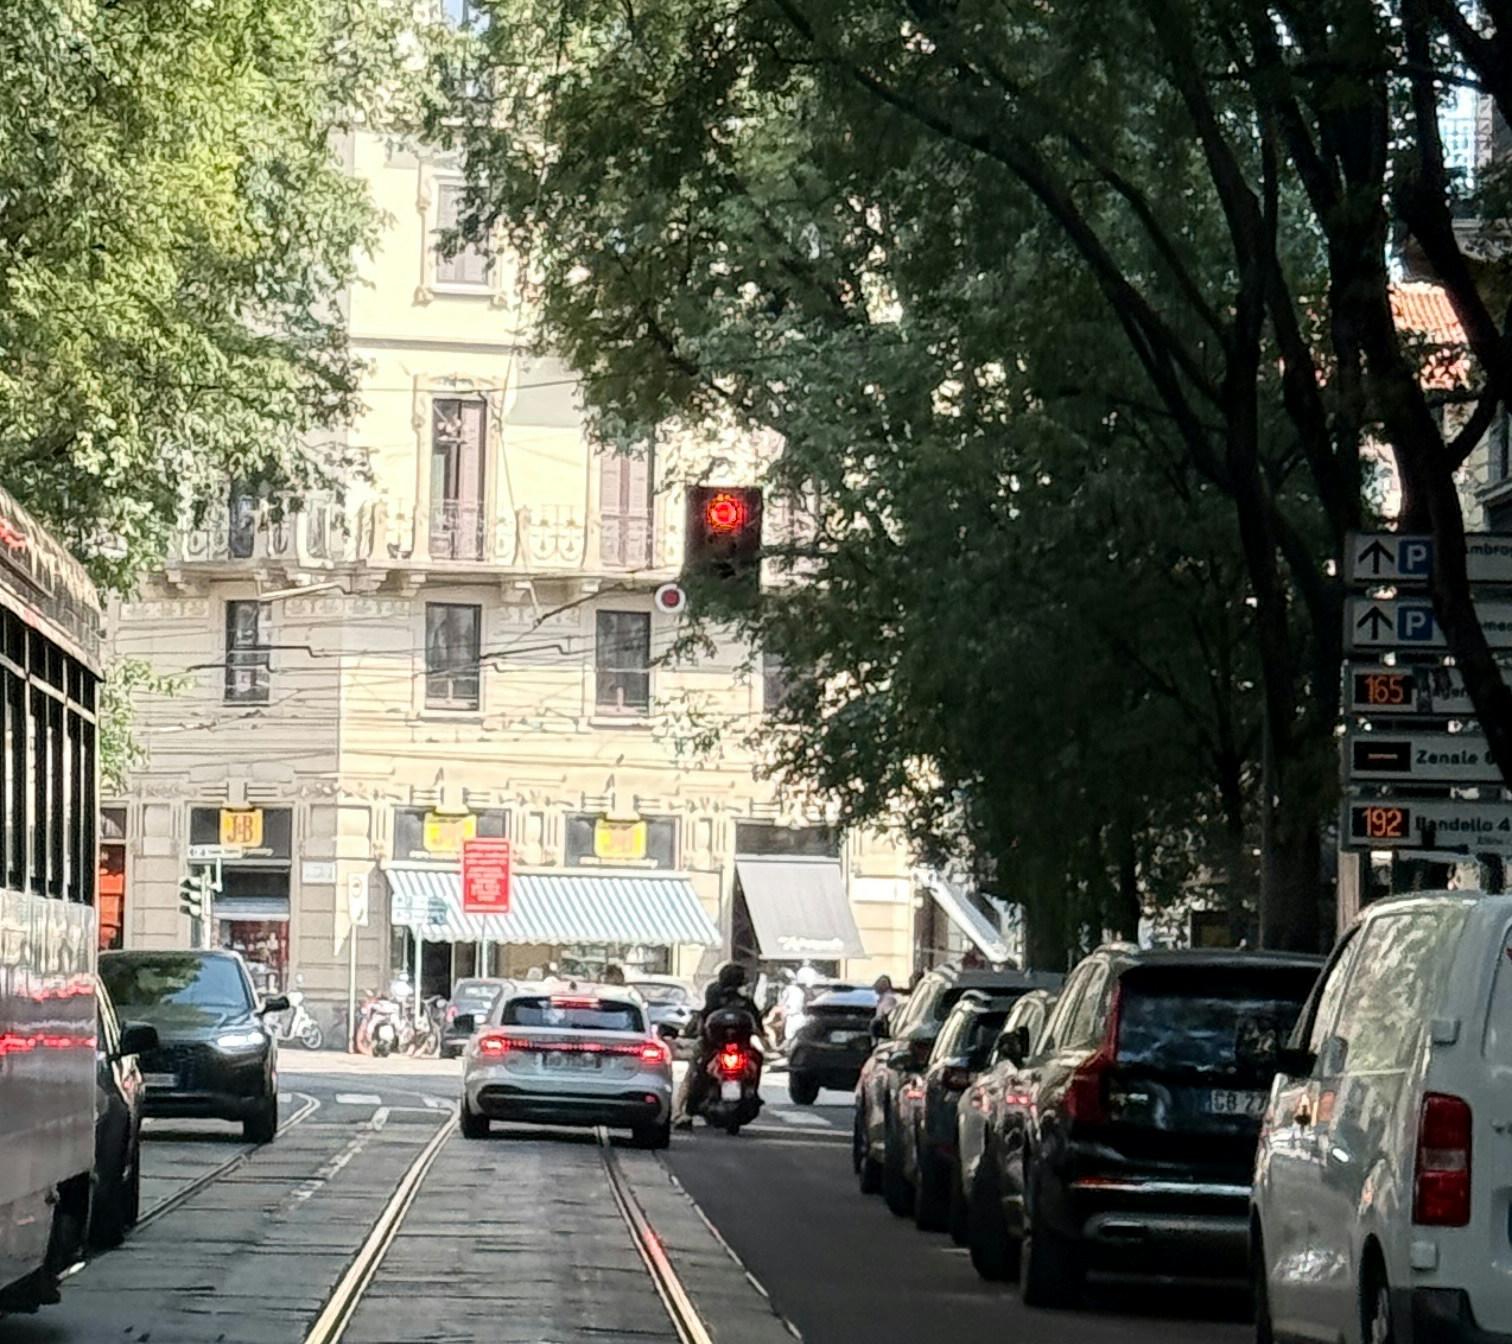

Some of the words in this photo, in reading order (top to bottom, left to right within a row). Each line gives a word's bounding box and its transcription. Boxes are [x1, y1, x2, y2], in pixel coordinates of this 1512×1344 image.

[1405, 544, 1428, 570] P
[1405, 610, 1427, 637] P
[1364, 675, 1405, 704] 165
[1416, 749, 1478, 766] Zenale
[1362, 807, 1403, 837] 192
